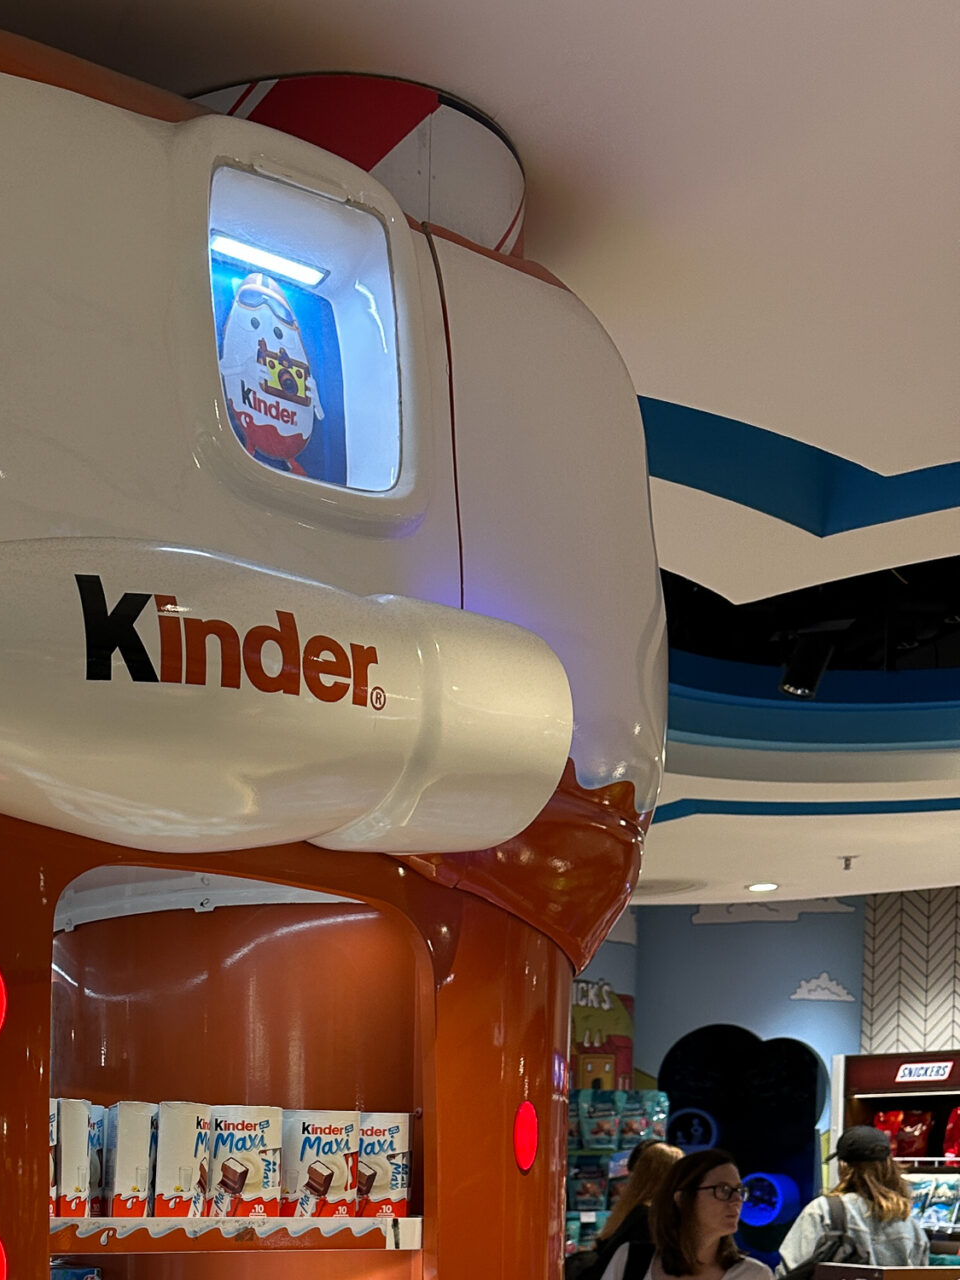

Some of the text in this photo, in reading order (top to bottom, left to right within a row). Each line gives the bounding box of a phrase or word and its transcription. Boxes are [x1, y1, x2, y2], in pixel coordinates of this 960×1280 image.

[901, 1062, 949, 1079] SNICKERS
[213, 1130, 267, 1159] Maxi
[300, 1134, 351, 1162] Maxi
